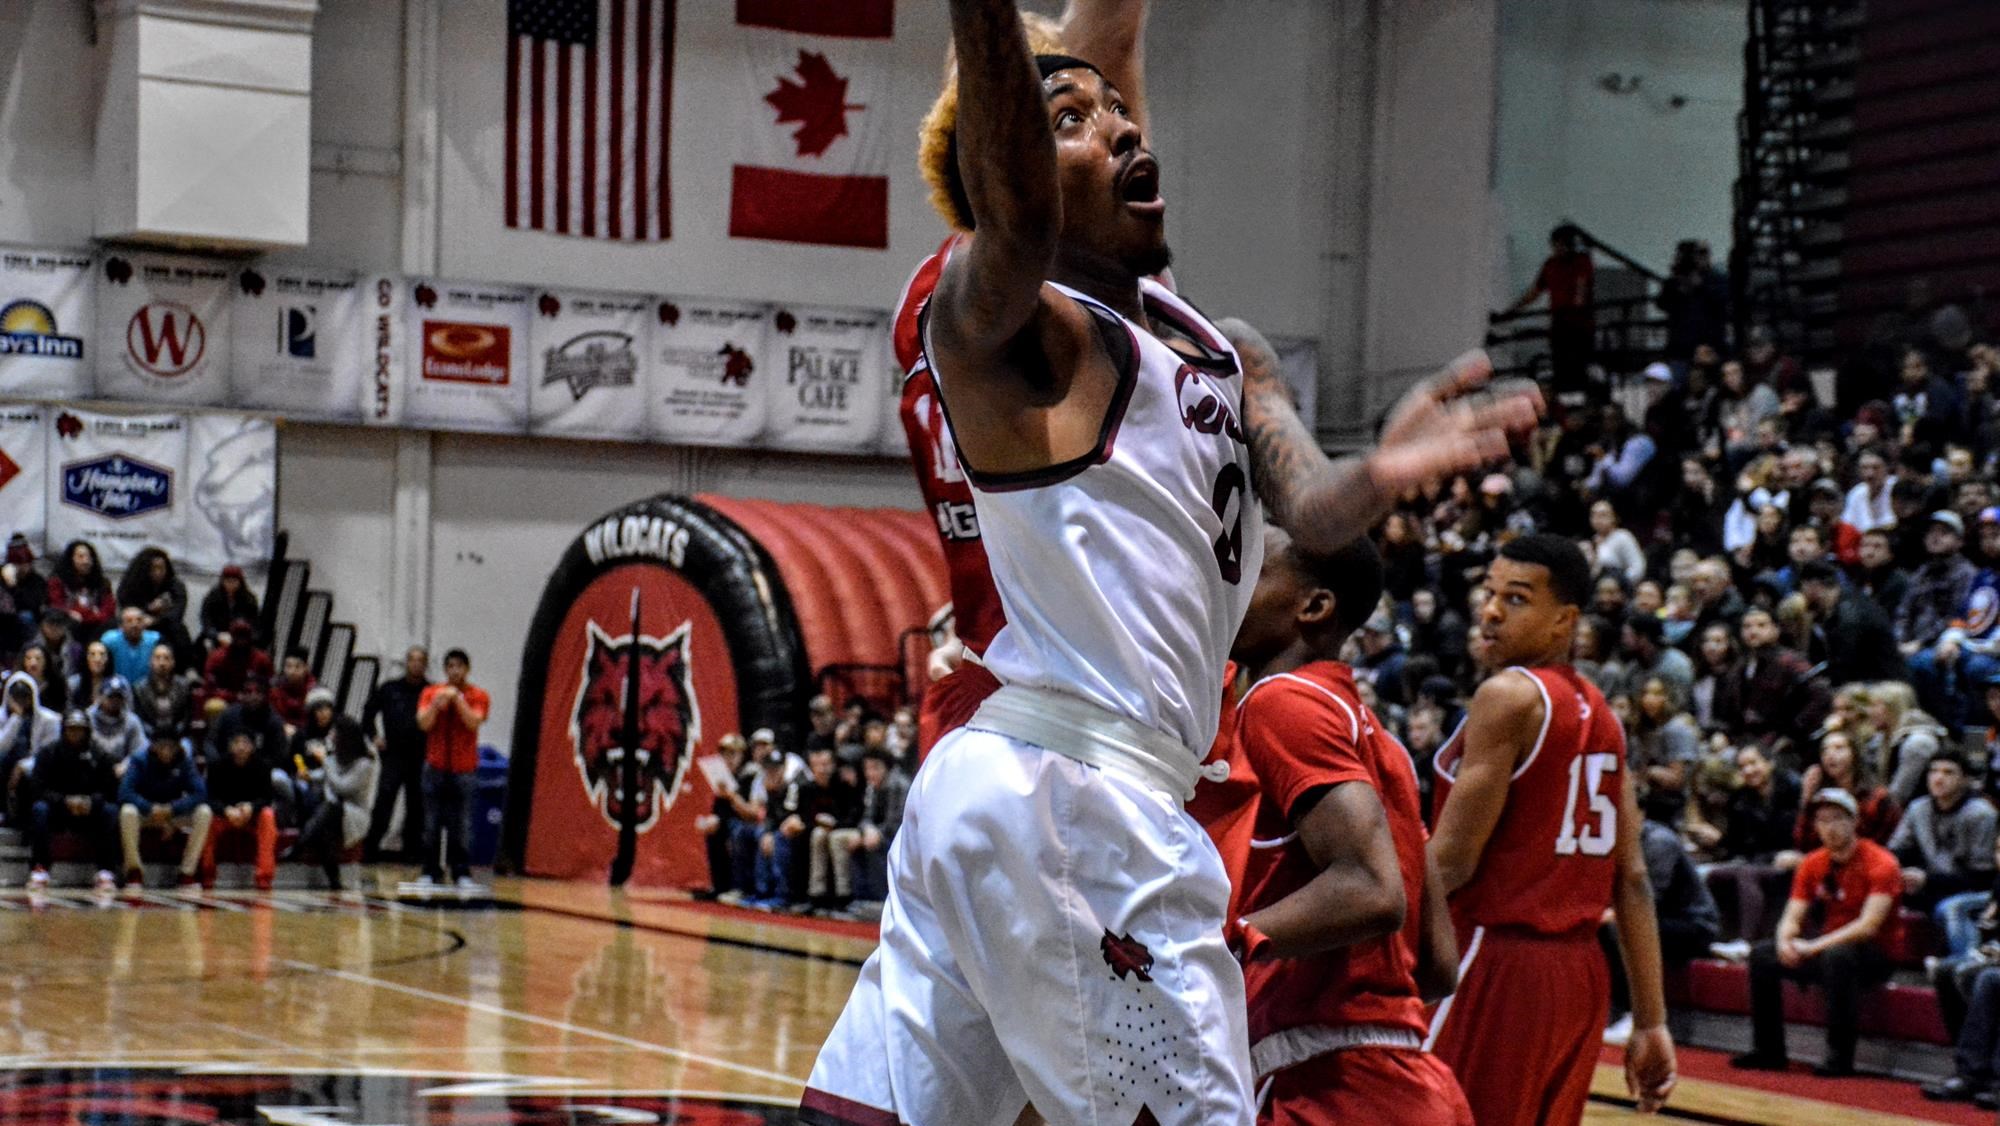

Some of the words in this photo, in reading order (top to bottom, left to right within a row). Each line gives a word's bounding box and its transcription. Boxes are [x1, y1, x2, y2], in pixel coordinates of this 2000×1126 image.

[37, 335, 78, 356] Inn
[584, 514, 690, 568] WILDCATS
[1555, 752, 1618, 856] 15
